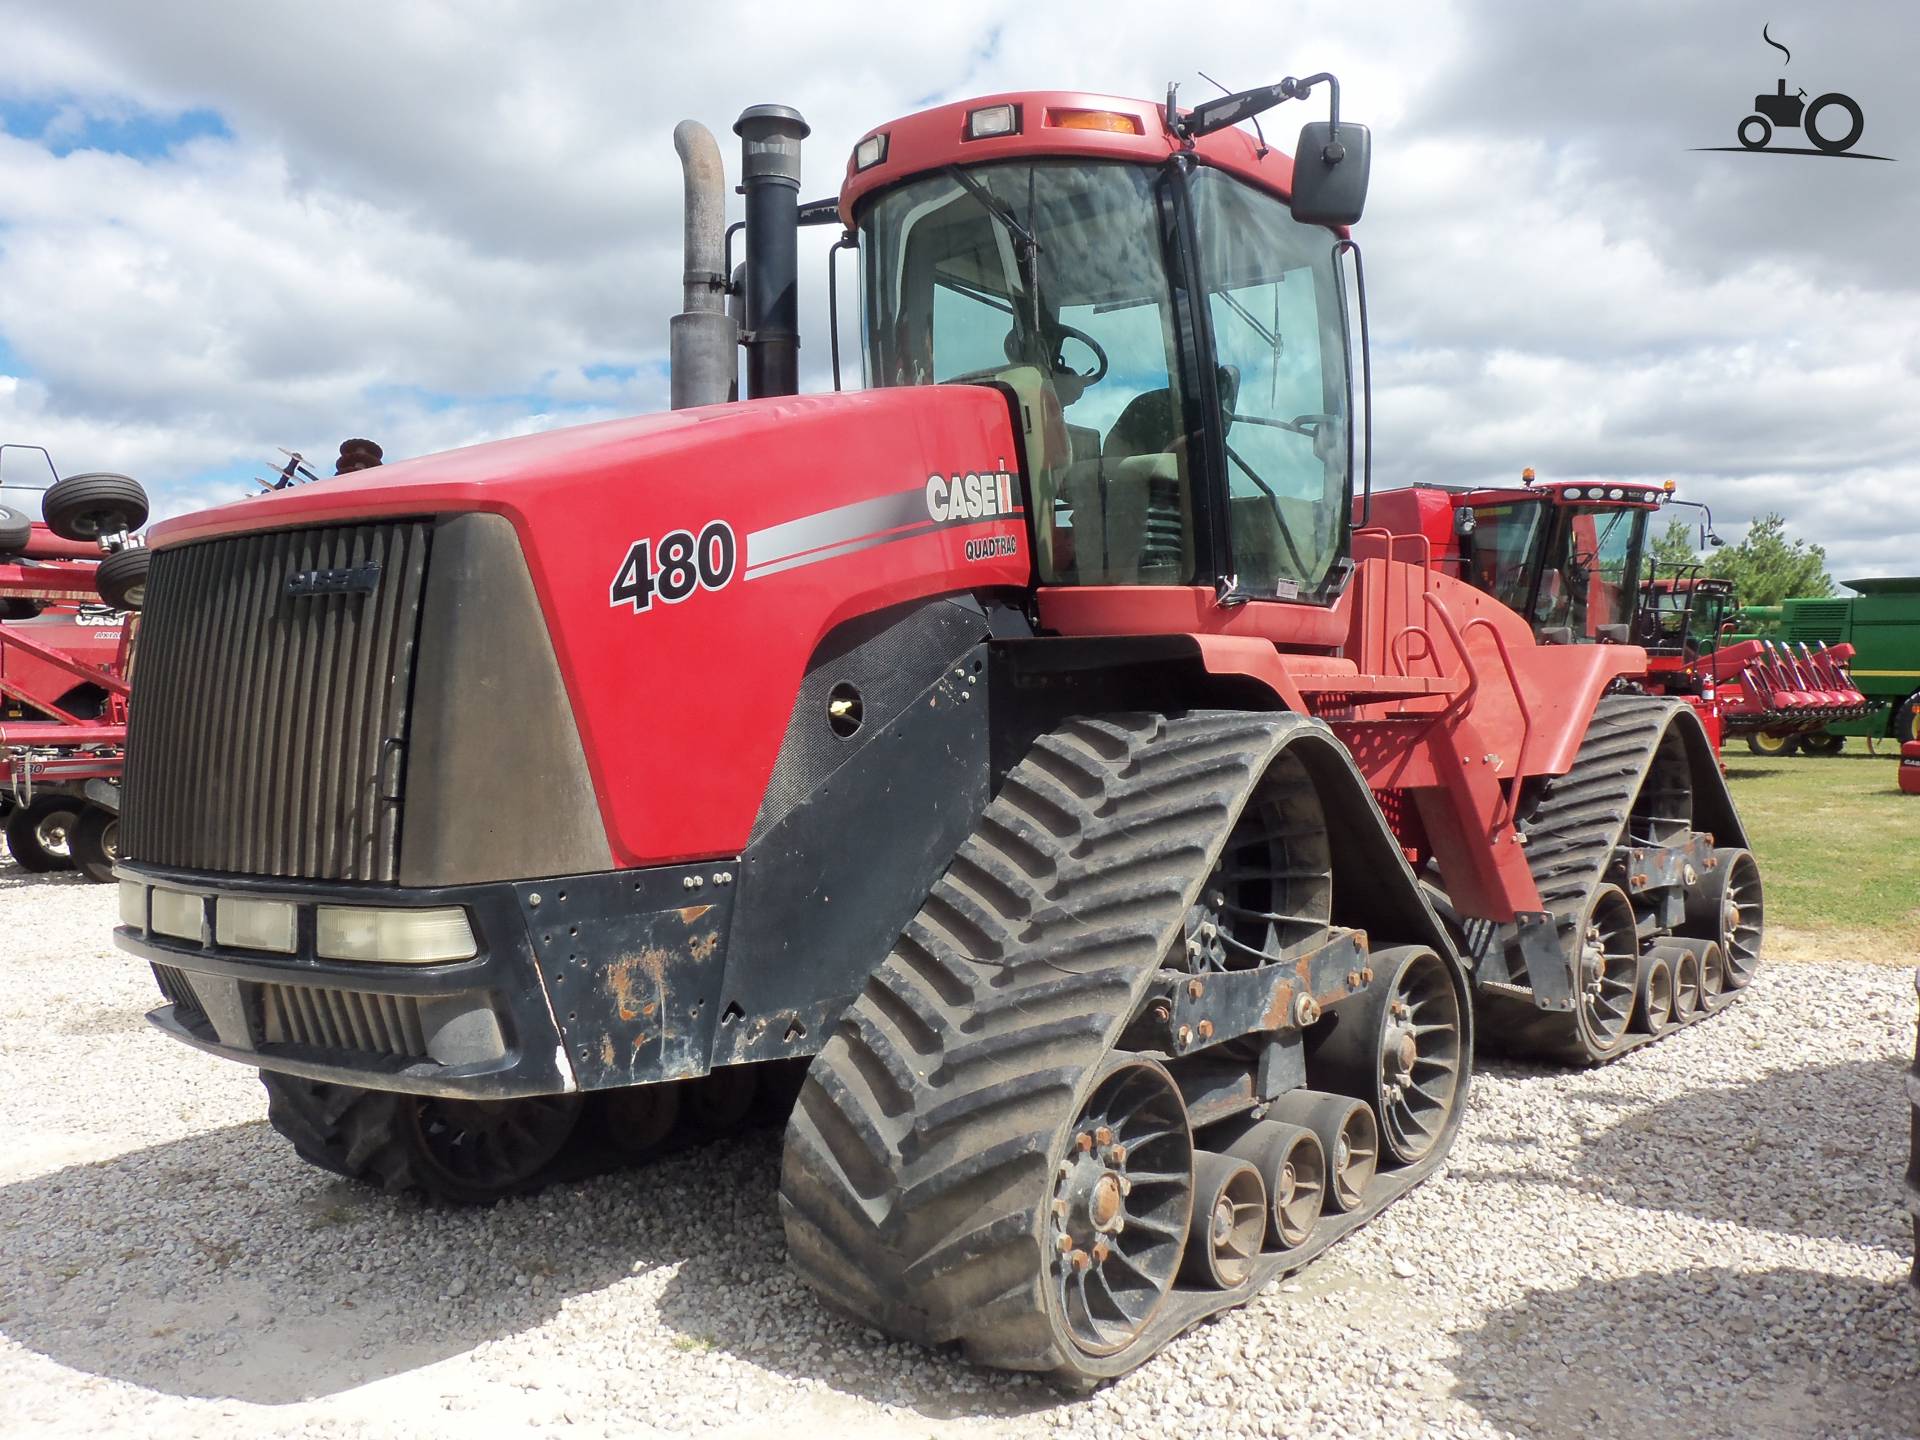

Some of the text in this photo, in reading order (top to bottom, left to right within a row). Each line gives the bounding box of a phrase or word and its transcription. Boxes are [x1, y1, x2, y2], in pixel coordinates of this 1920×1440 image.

[965, 535, 1017, 562] QUADTRAC
[609, 519, 737, 614] 480
[94, 631, 121, 640] AXIA
